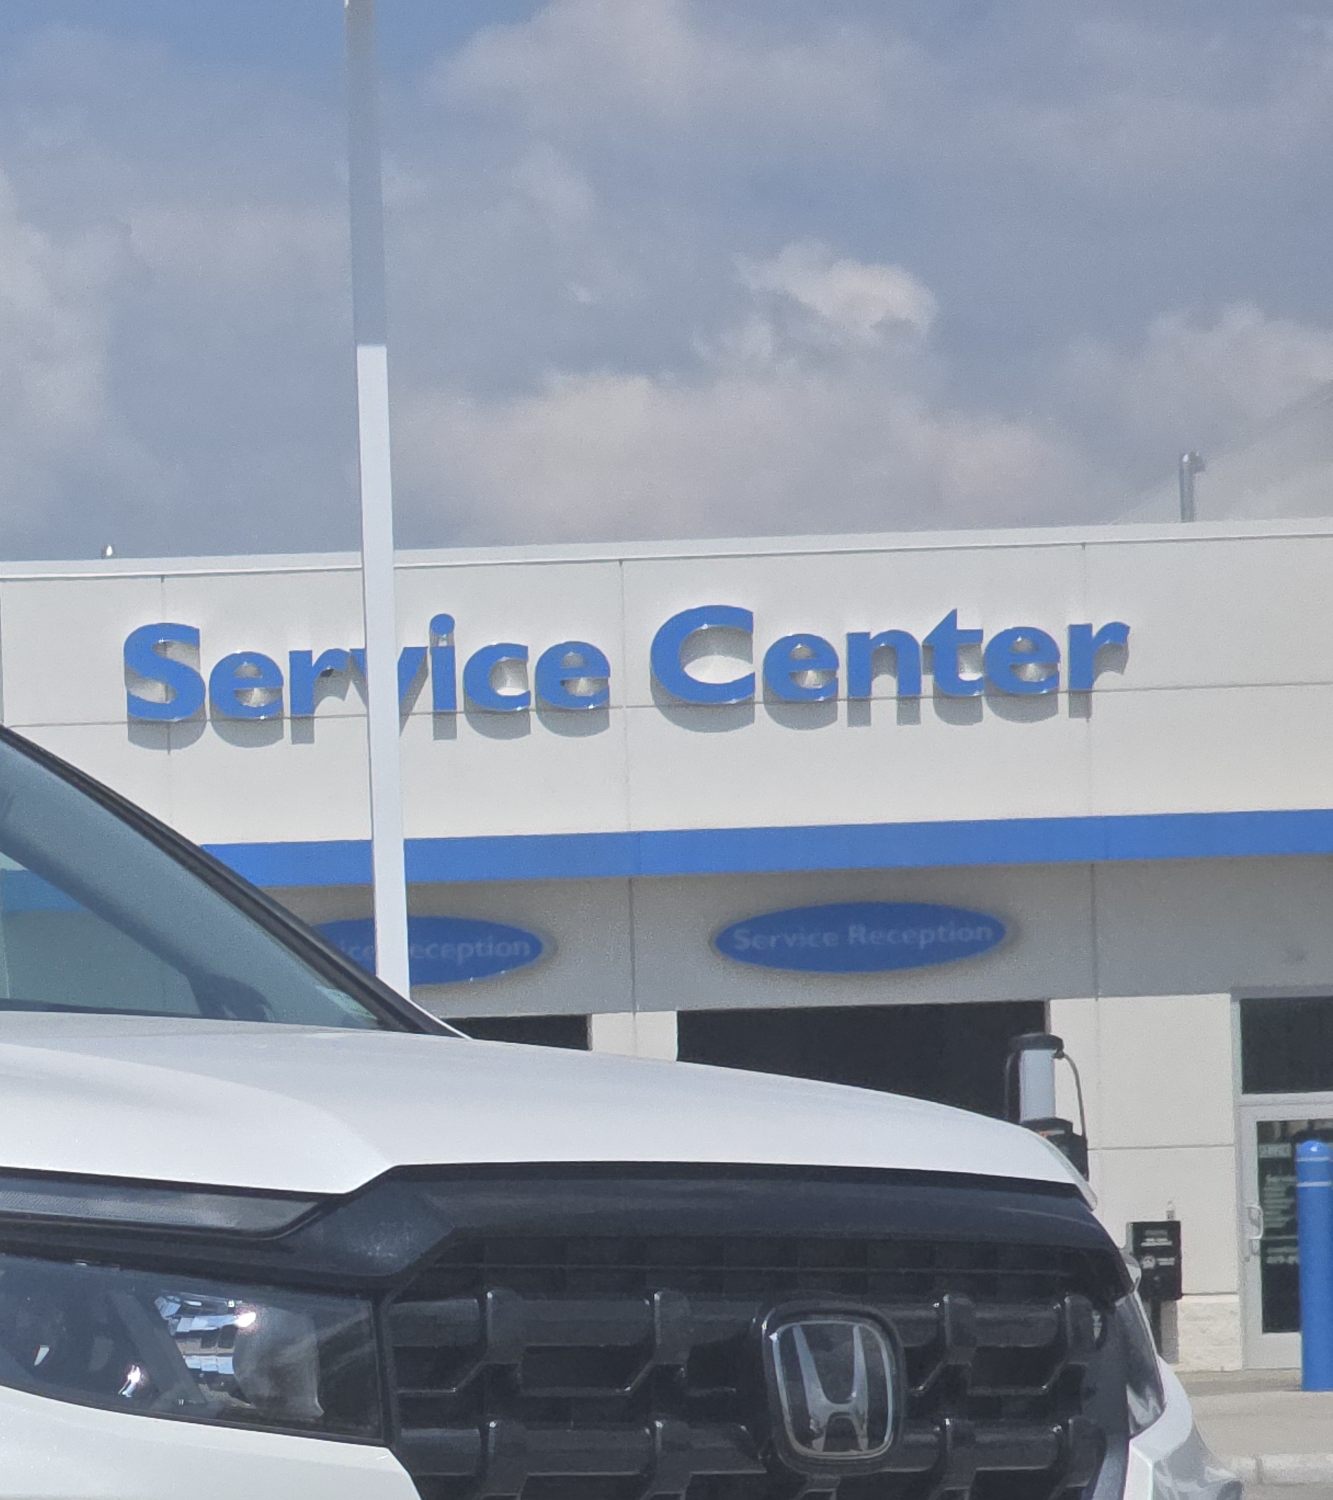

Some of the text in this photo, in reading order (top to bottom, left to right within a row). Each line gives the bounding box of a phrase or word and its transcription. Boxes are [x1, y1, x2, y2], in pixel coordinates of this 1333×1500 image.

[650, 605, 1129, 704] Center
[410, 934, 531, 965] eception
[733, 921, 993, 951] Service Reception
